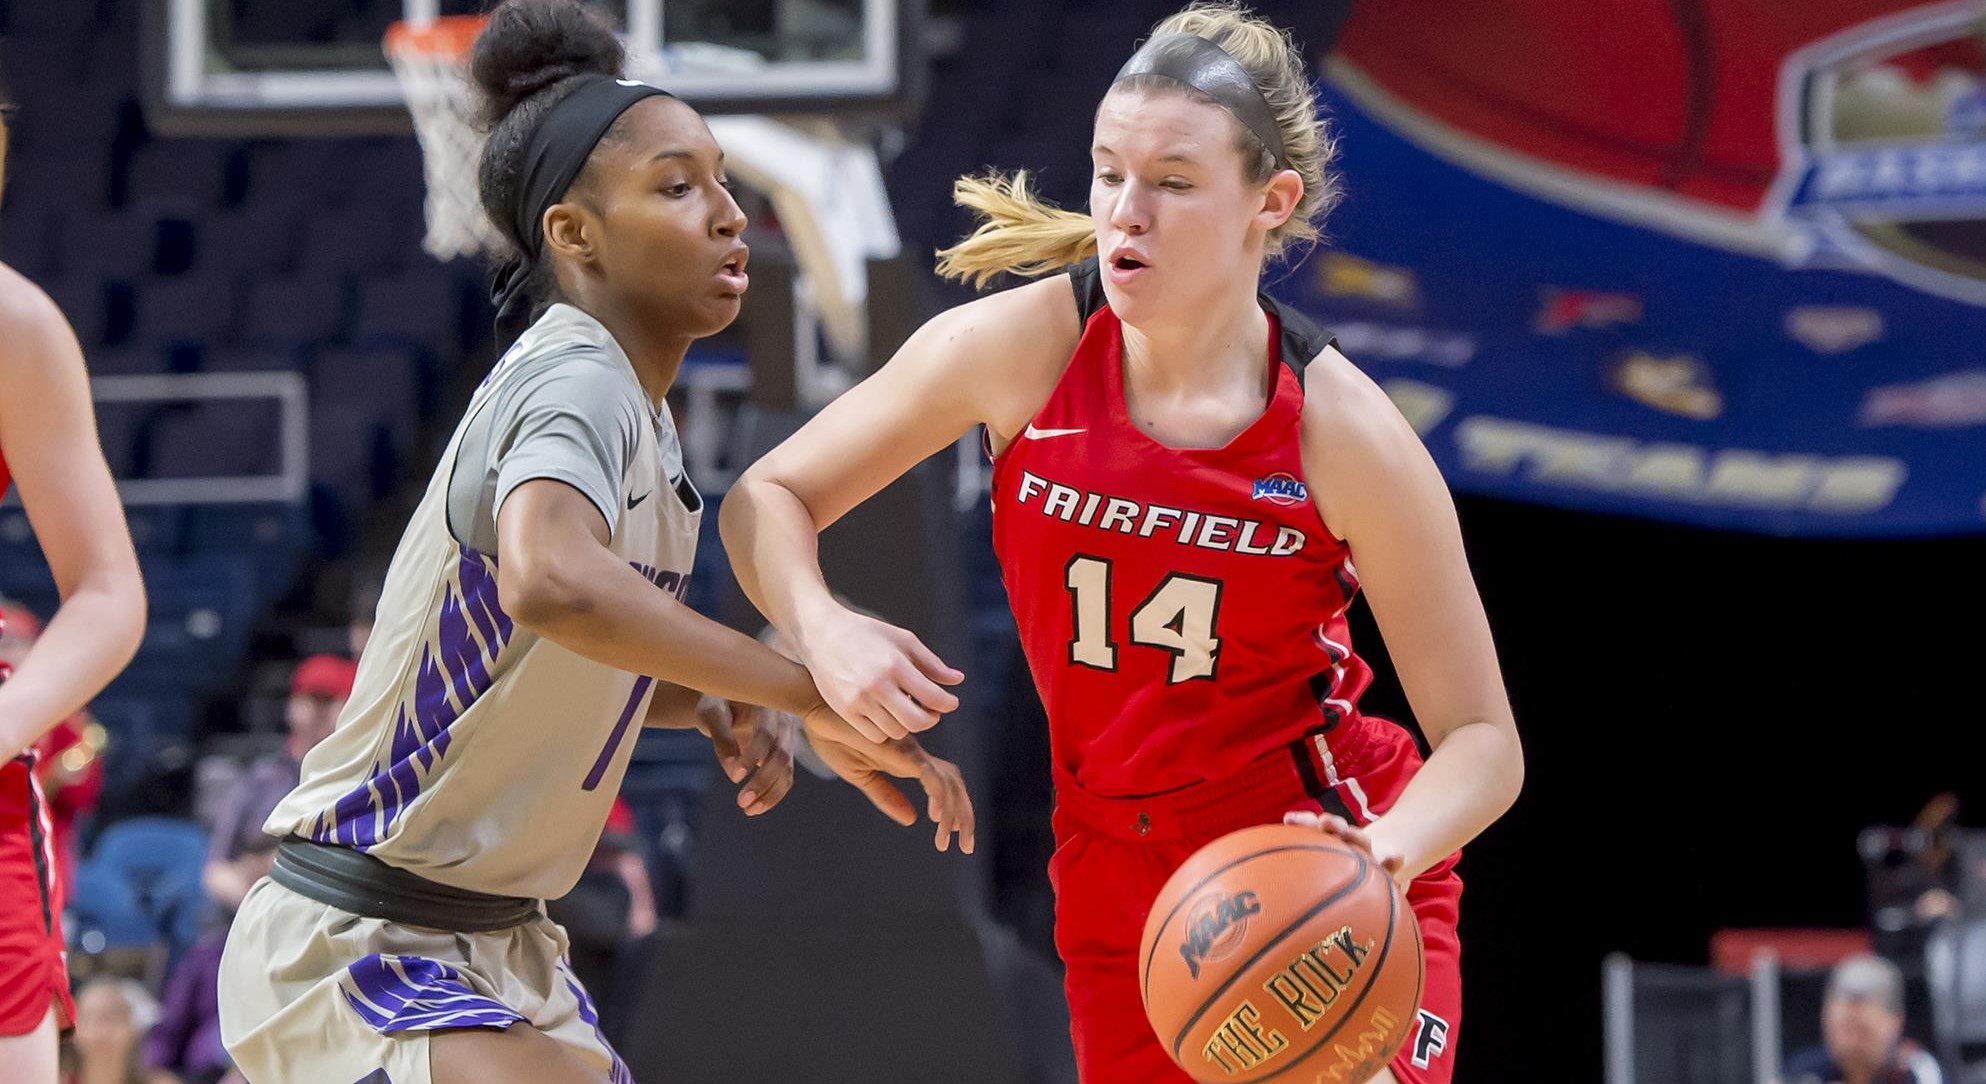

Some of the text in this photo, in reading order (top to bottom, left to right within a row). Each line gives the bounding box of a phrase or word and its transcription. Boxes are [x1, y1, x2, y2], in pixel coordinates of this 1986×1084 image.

[1016, 470, 1306, 556] FAIRFIELD
[1252, 478, 1308, 502] MAAC
[1064, 552, 1224, 686] 14
[1179, 891, 1260, 979] MAAC
[1202, 999, 1290, 1075] THE
[1262, 925, 1374, 1032] ROCK
[1411, 1008, 1450, 1071] F
